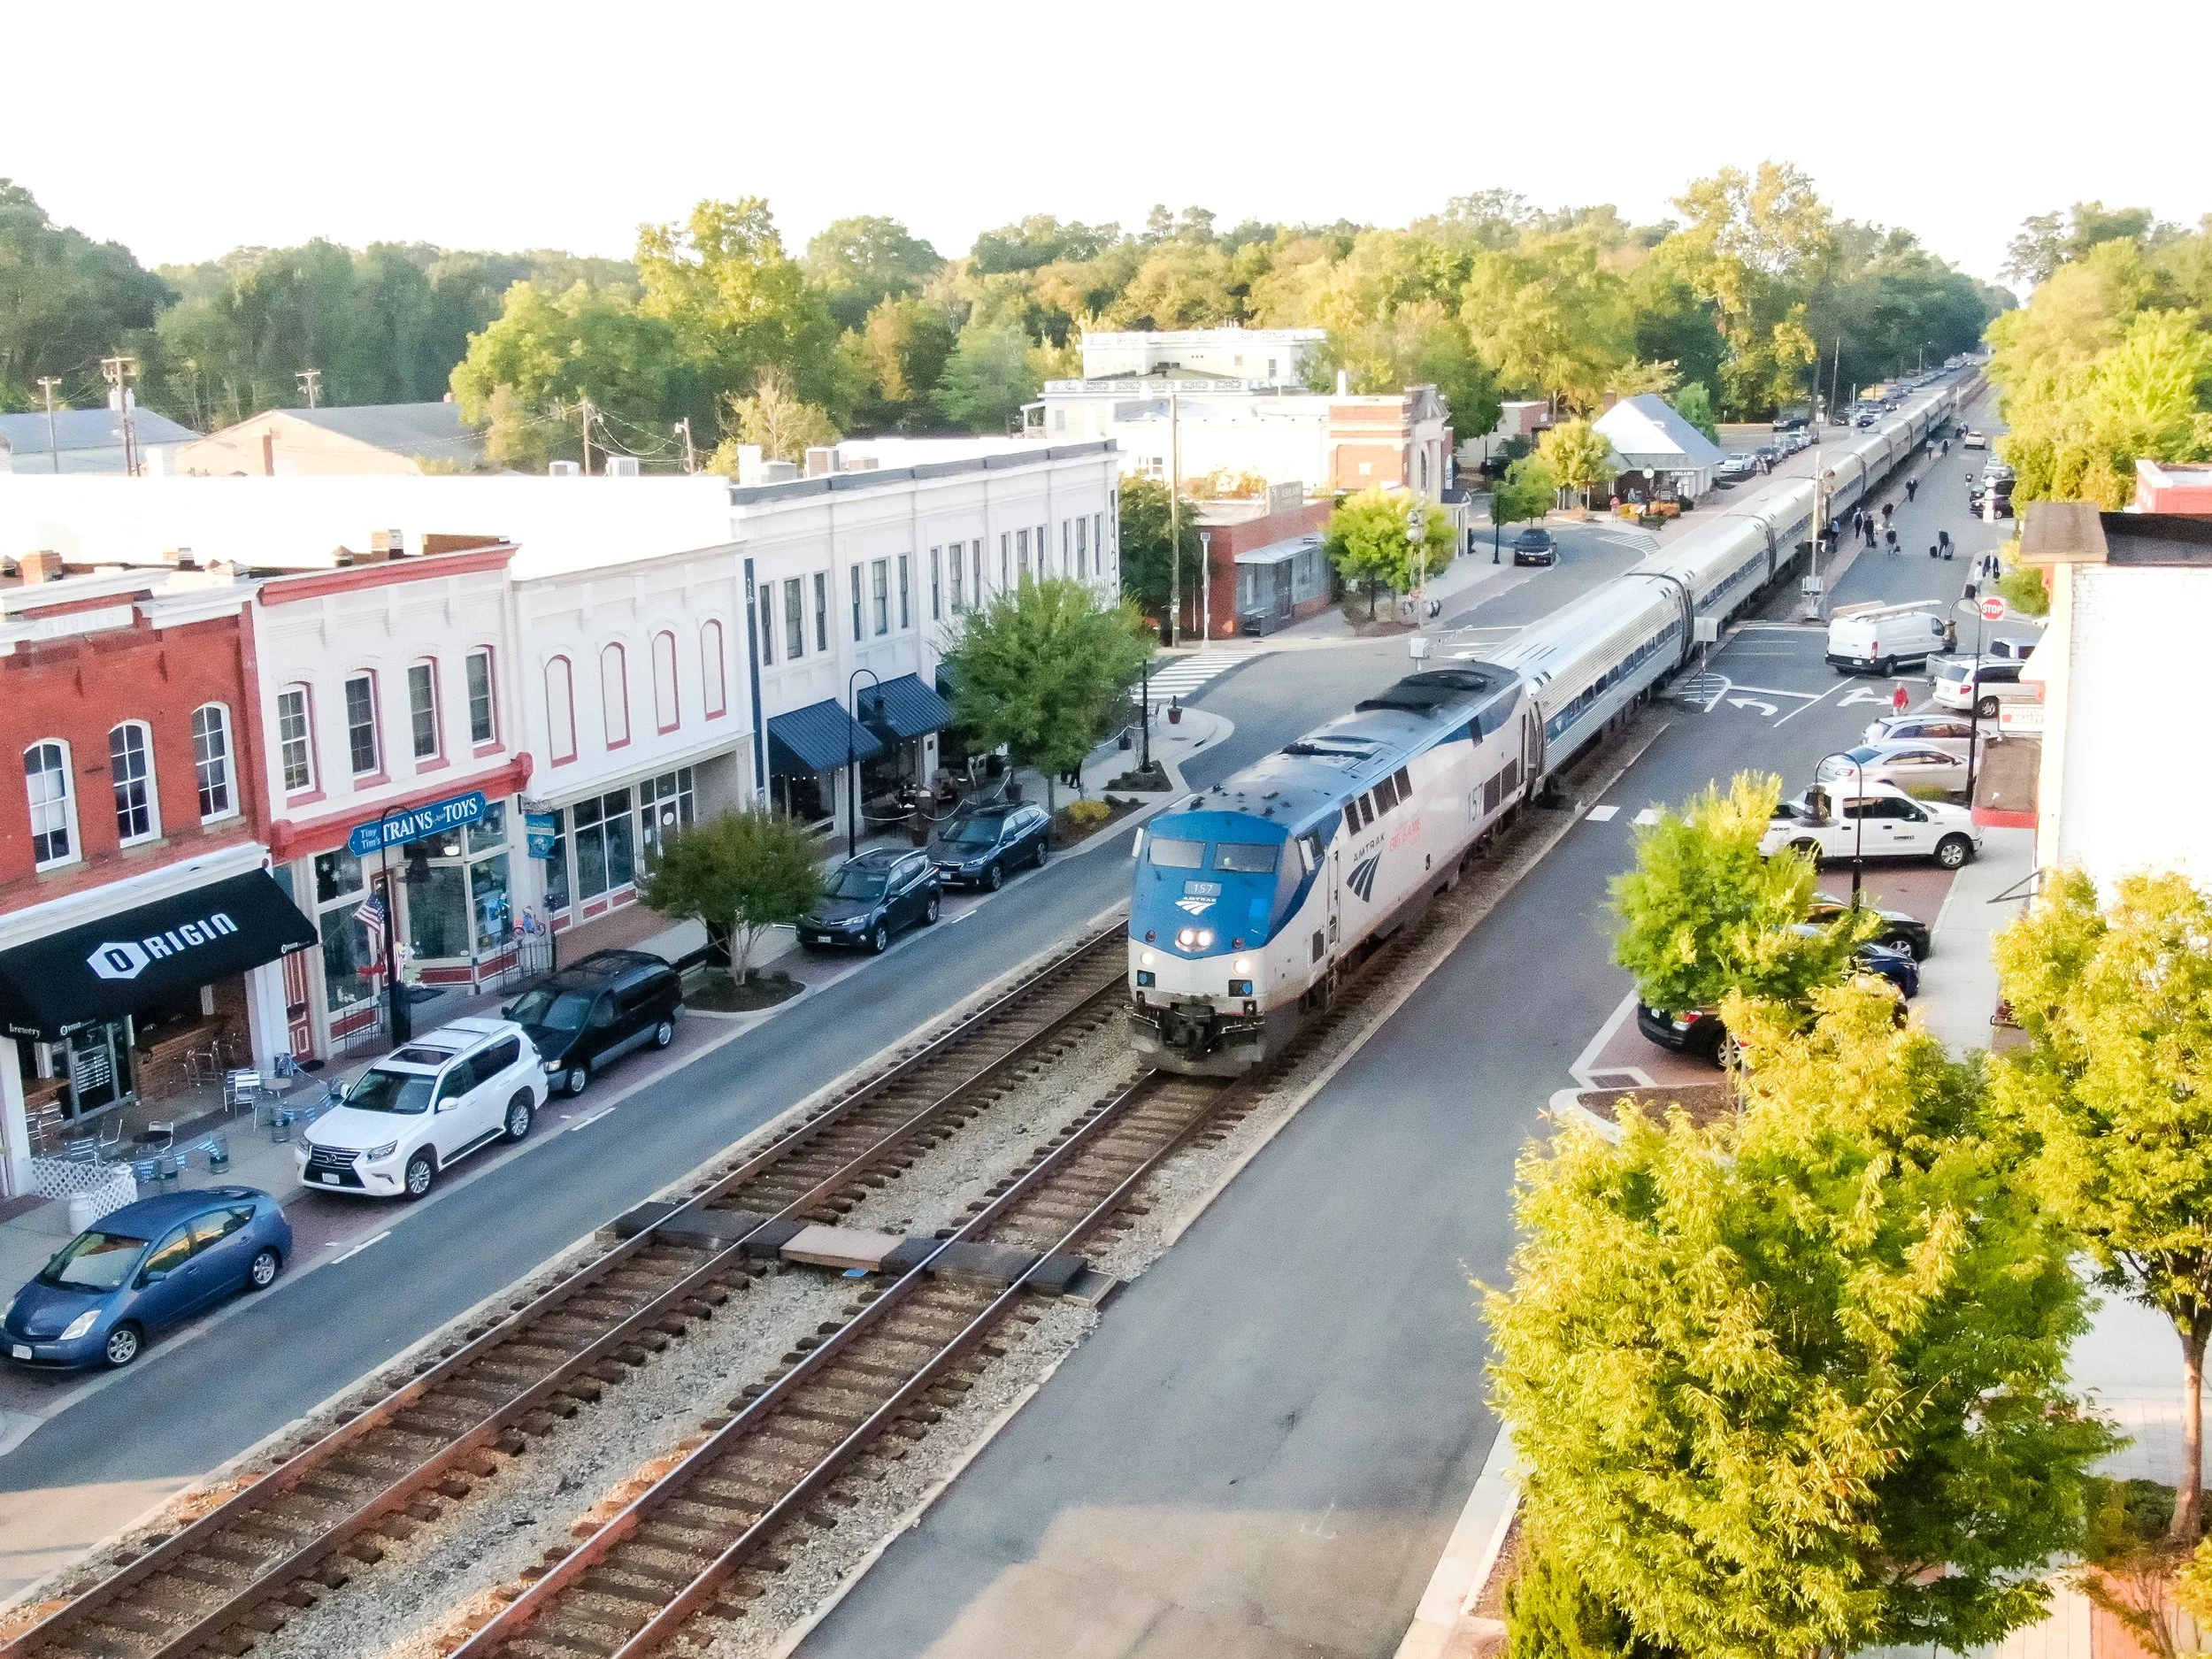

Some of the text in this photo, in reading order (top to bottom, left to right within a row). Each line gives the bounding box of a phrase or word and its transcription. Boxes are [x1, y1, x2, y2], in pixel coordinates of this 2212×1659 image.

[1982, 603, 2003, 614] STOP
[443, 798, 478, 823] TOYS
[1467, 782, 1484, 823] 157
[360, 828, 377, 840] Tiny
[361, 837, 381, 849] Tim's
[1353, 832, 1386, 864] AMTRAK
[1194, 883, 1213, 894] 157
[87, 913, 238, 979] ORIGIN
